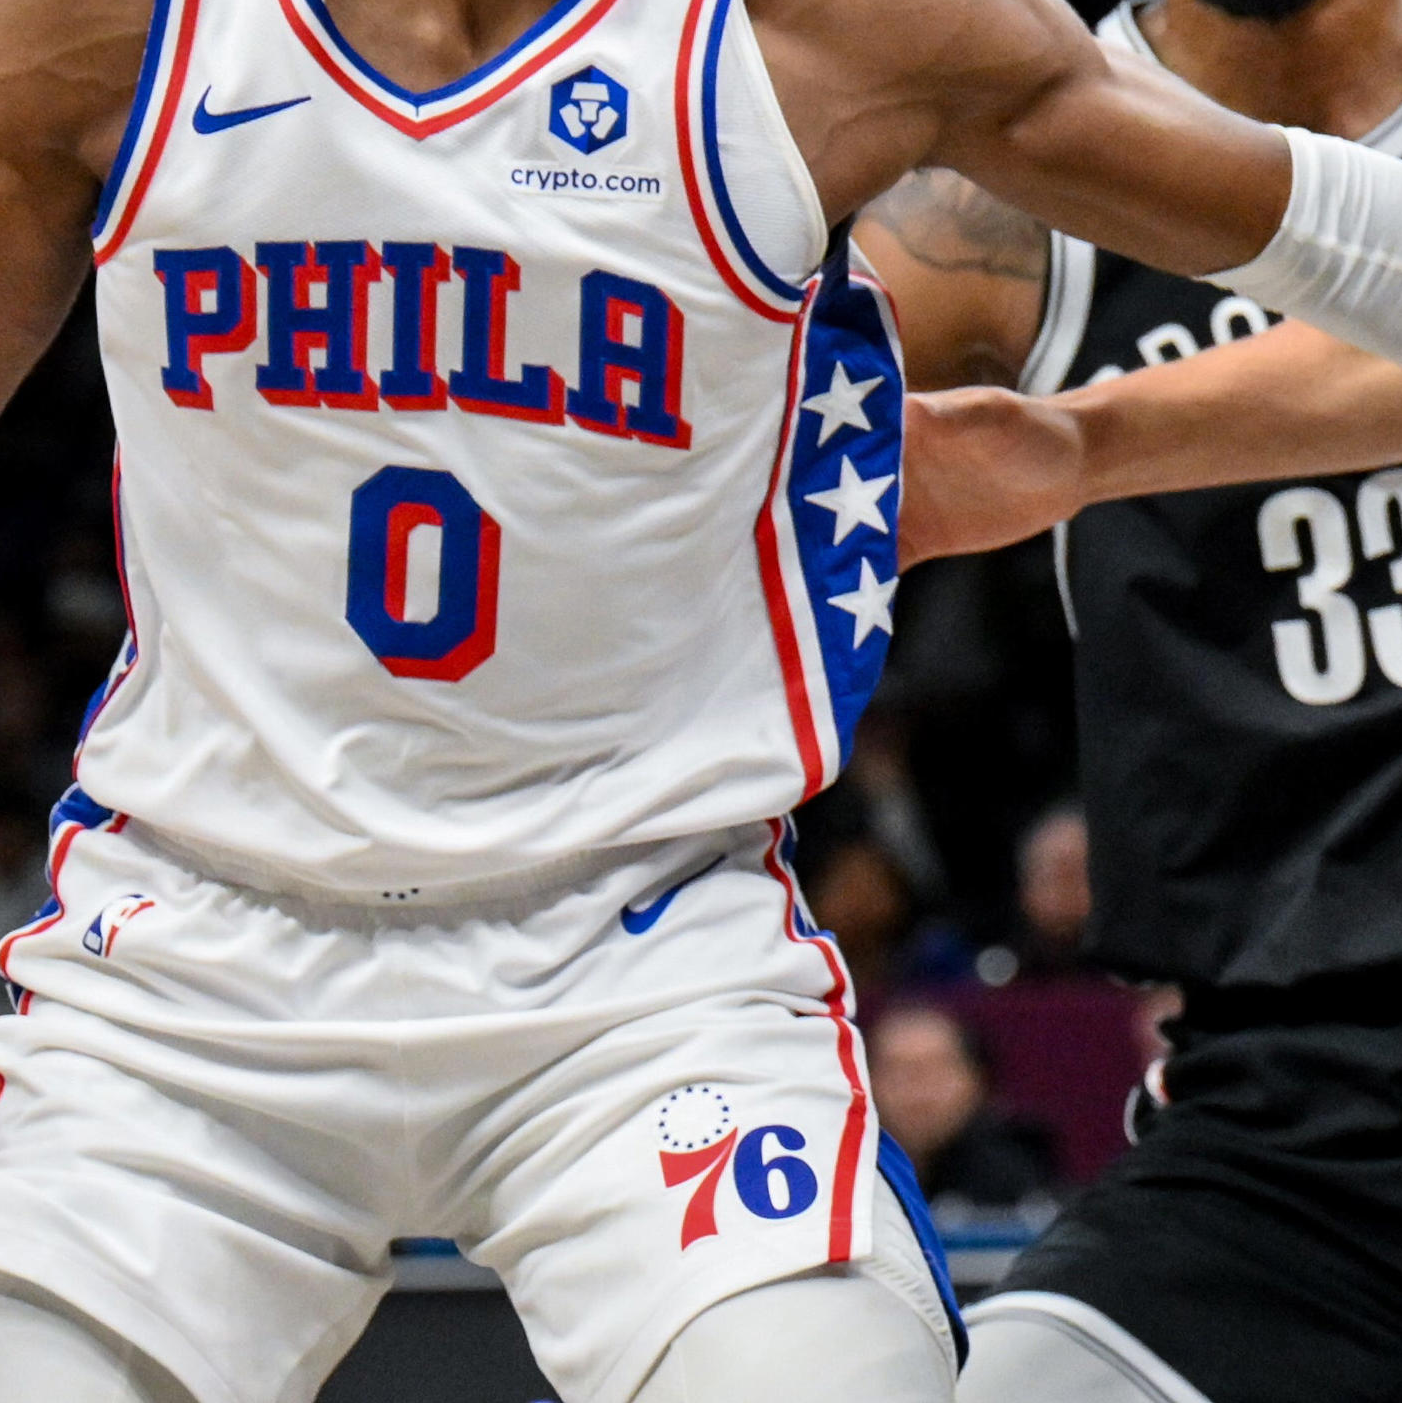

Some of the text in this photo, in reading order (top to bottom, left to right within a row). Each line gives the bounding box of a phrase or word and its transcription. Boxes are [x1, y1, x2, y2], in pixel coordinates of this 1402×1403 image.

[510, 167, 661, 194] crypto.com
[153, 239, 693, 451] PHILA
[345, 464, 502, 684] 0
[658, 1123, 819, 1252] 76
